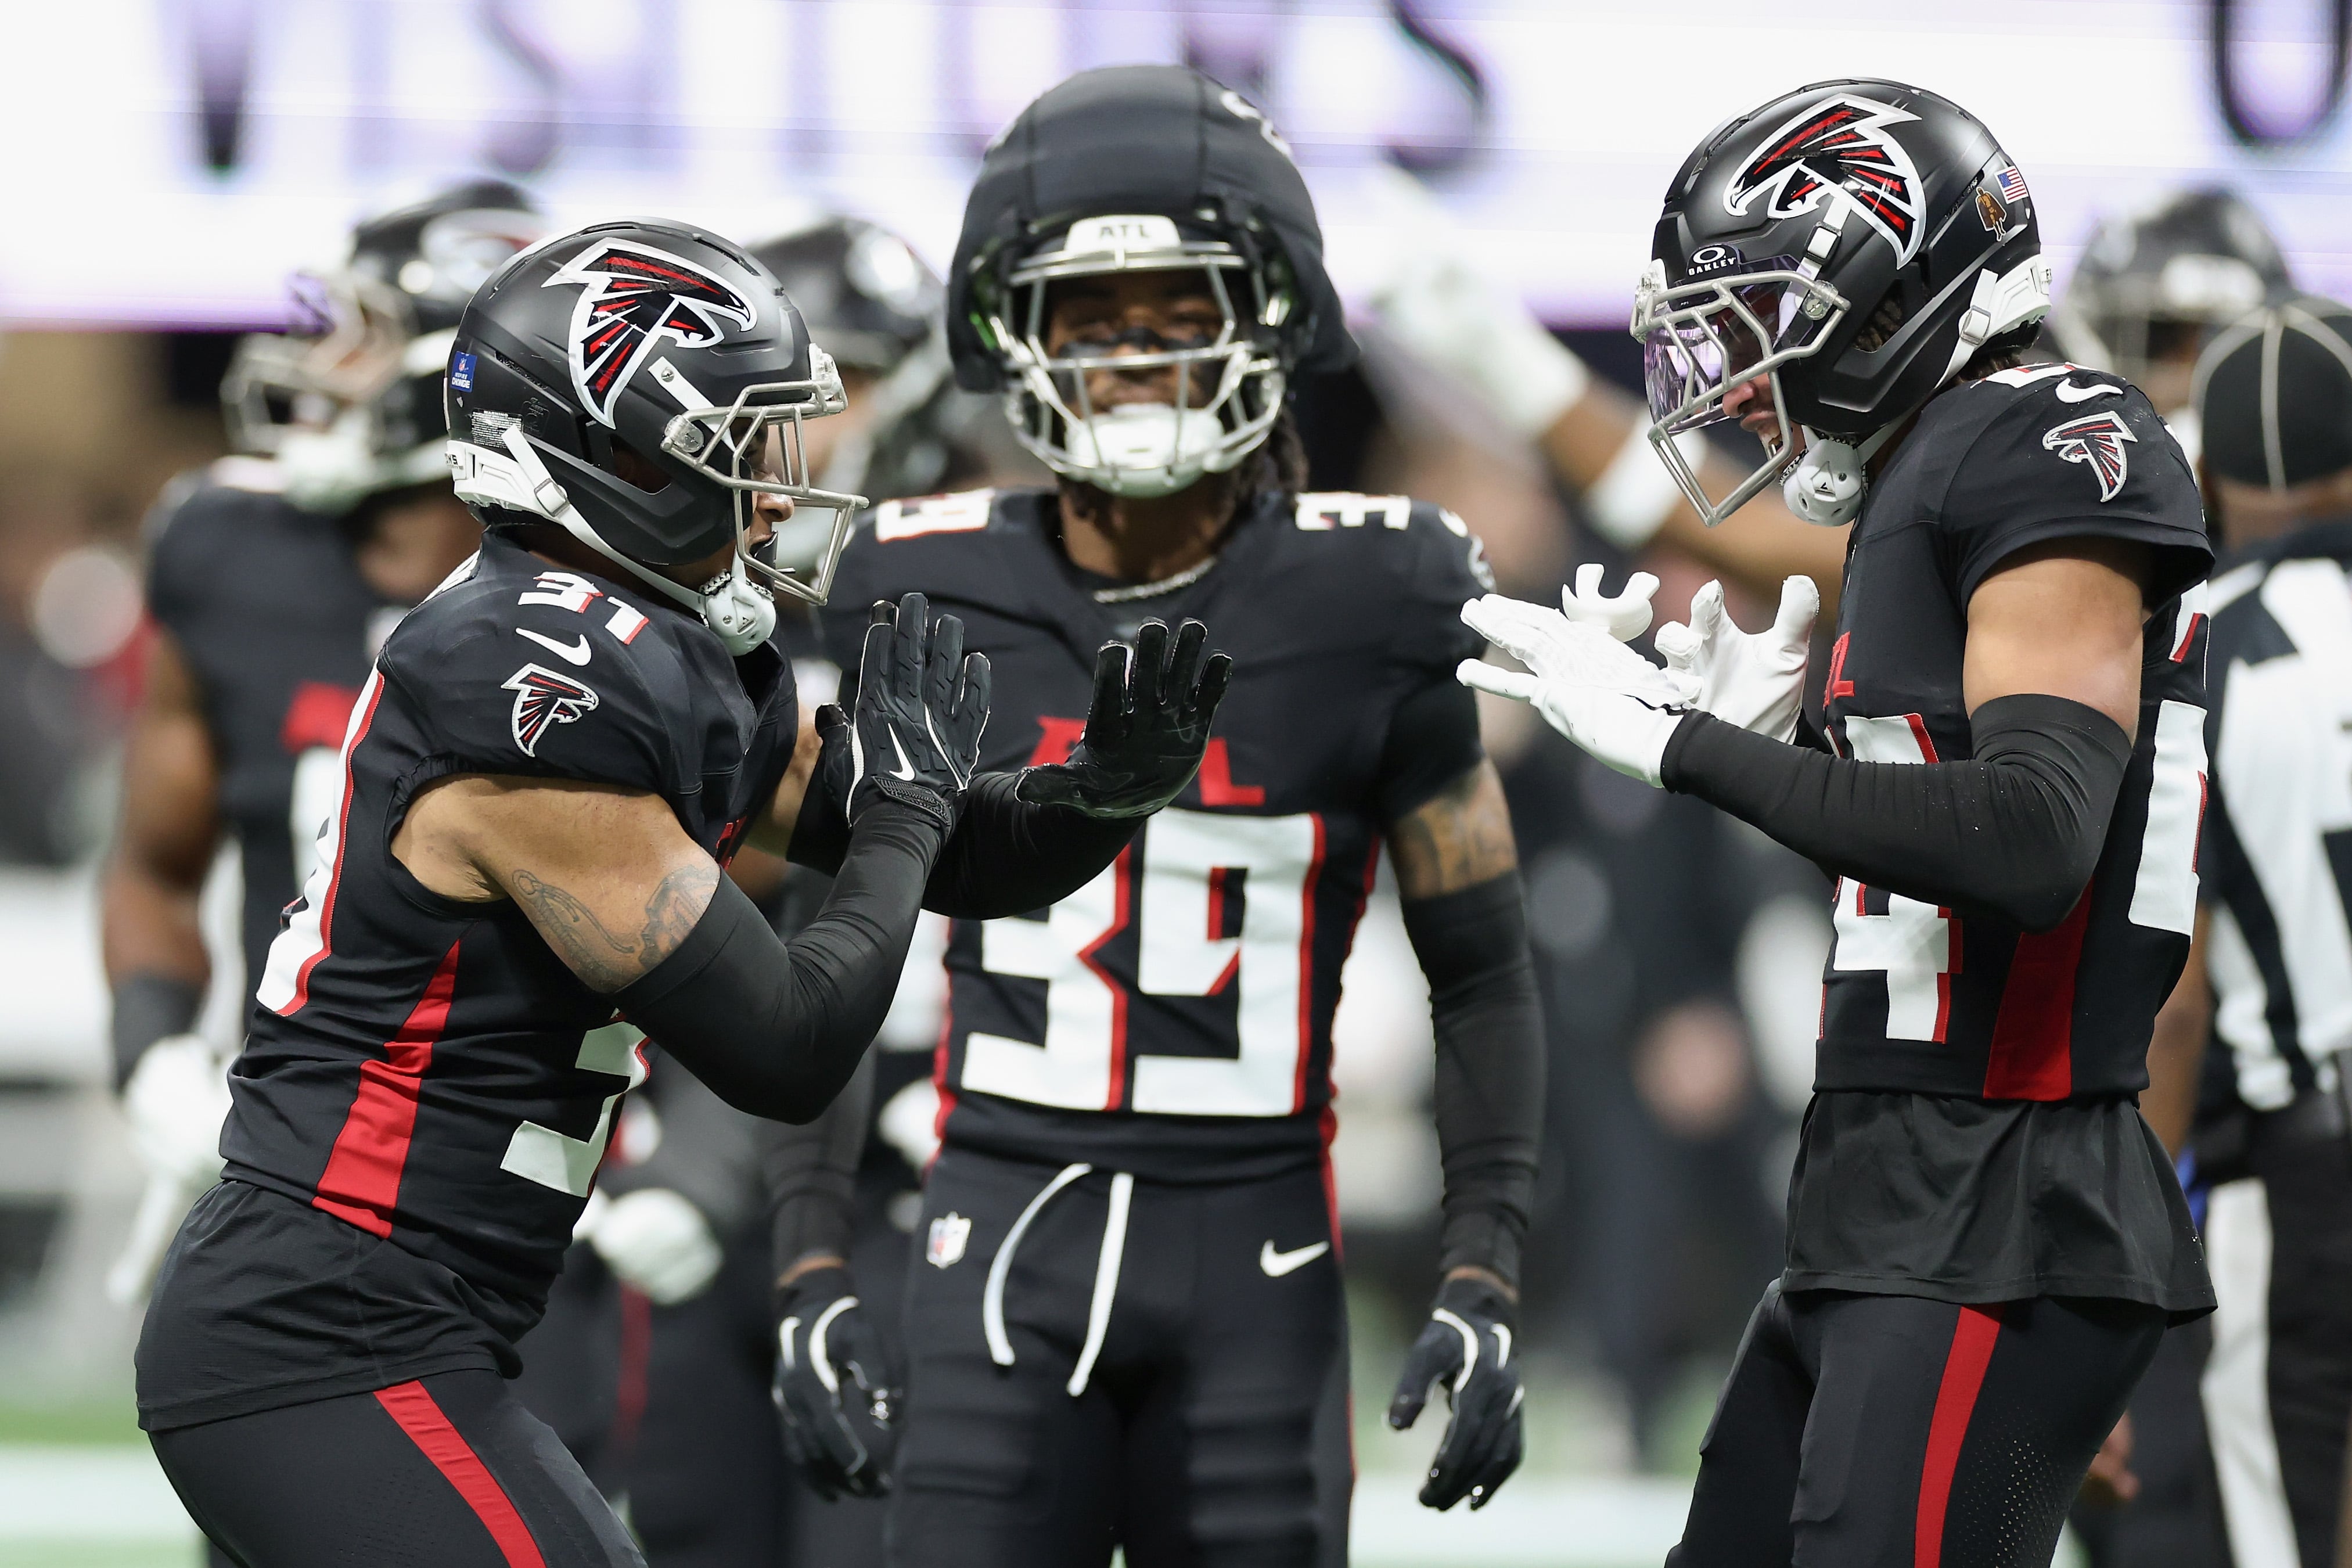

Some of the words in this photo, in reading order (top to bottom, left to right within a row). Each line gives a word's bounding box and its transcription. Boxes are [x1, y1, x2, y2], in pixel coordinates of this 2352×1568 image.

[1099, 224, 1150, 239] ATL
[1688, 257, 1735, 276] OAKLEY
[452, 376, 471, 389] CHANGE
[517, 571, 650, 646] 31
[1027, 715, 1266, 807] AL
[961, 807, 1326, 1116] 39
